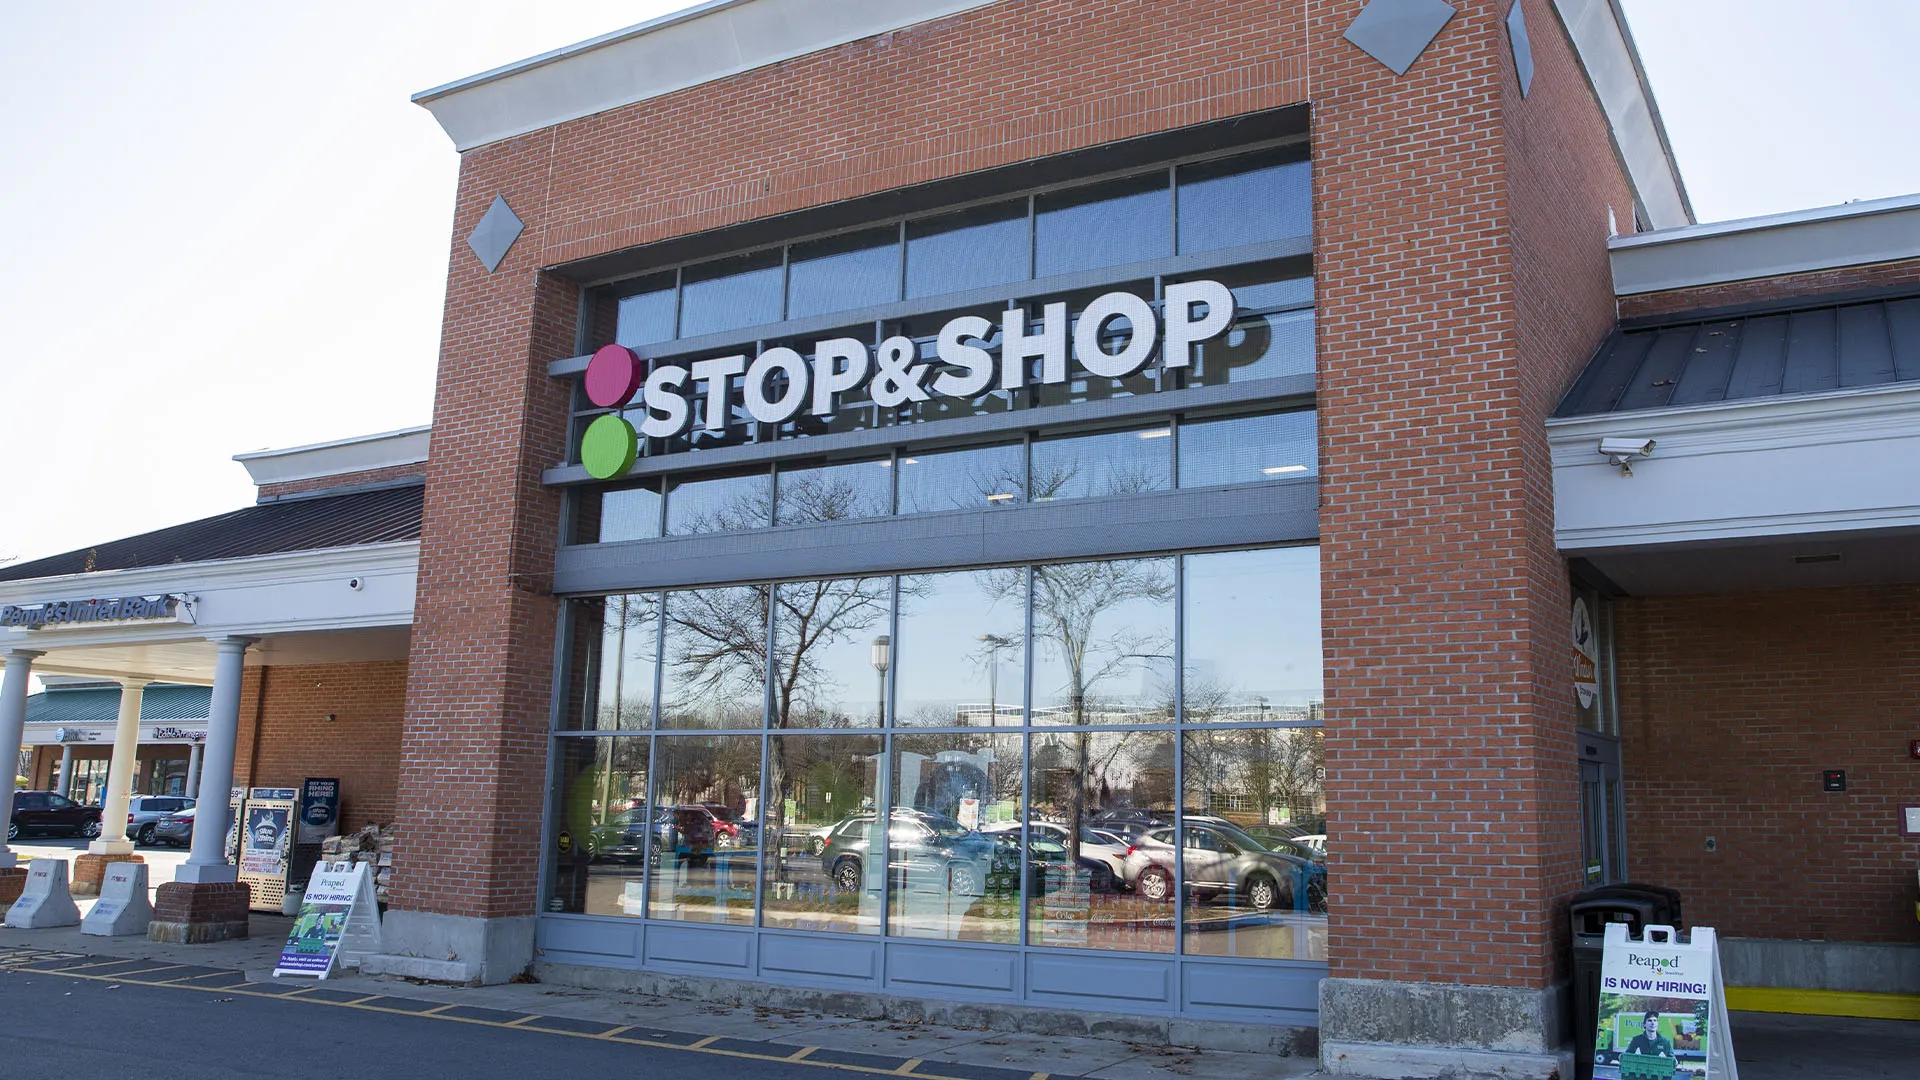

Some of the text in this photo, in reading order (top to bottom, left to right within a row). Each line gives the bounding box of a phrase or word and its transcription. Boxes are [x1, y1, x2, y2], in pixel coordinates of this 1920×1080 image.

[641, 279, 1236, 439] STOP&SHOP
[66, 598, 118, 623] United
[119, 593, 168, 620] Bank
[320, 879, 346, 889] Peapod
[313, 893, 329, 901] NOW
[329, 894, 353, 902] HIRING!
[1056, 911, 1075, 920] Coke
[1628, 953, 1680, 969] Peapod
[1604, 977, 1707, 995] IS NOW HIRING!
